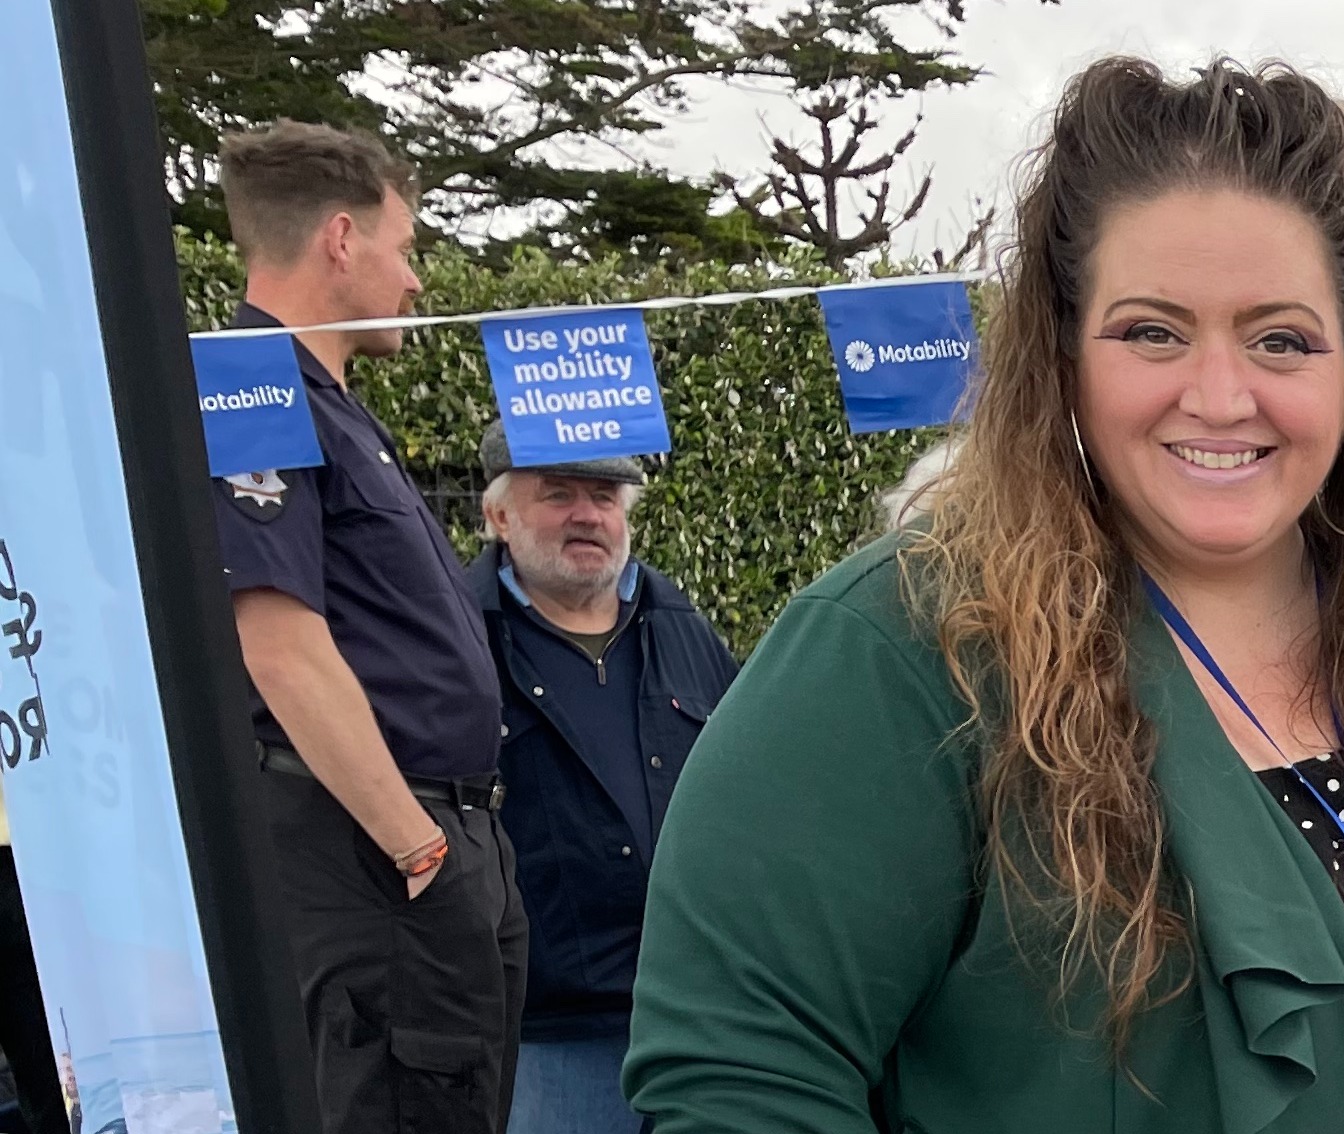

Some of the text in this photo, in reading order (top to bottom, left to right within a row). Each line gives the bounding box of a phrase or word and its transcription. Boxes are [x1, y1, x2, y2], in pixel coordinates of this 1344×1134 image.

[503, 323, 628, 354] Use your
[877, 338, 971, 364] Motability
[513, 350, 633, 384] mobility
[510, 385, 653, 417] allowance
[555, 418, 622, 444] here
